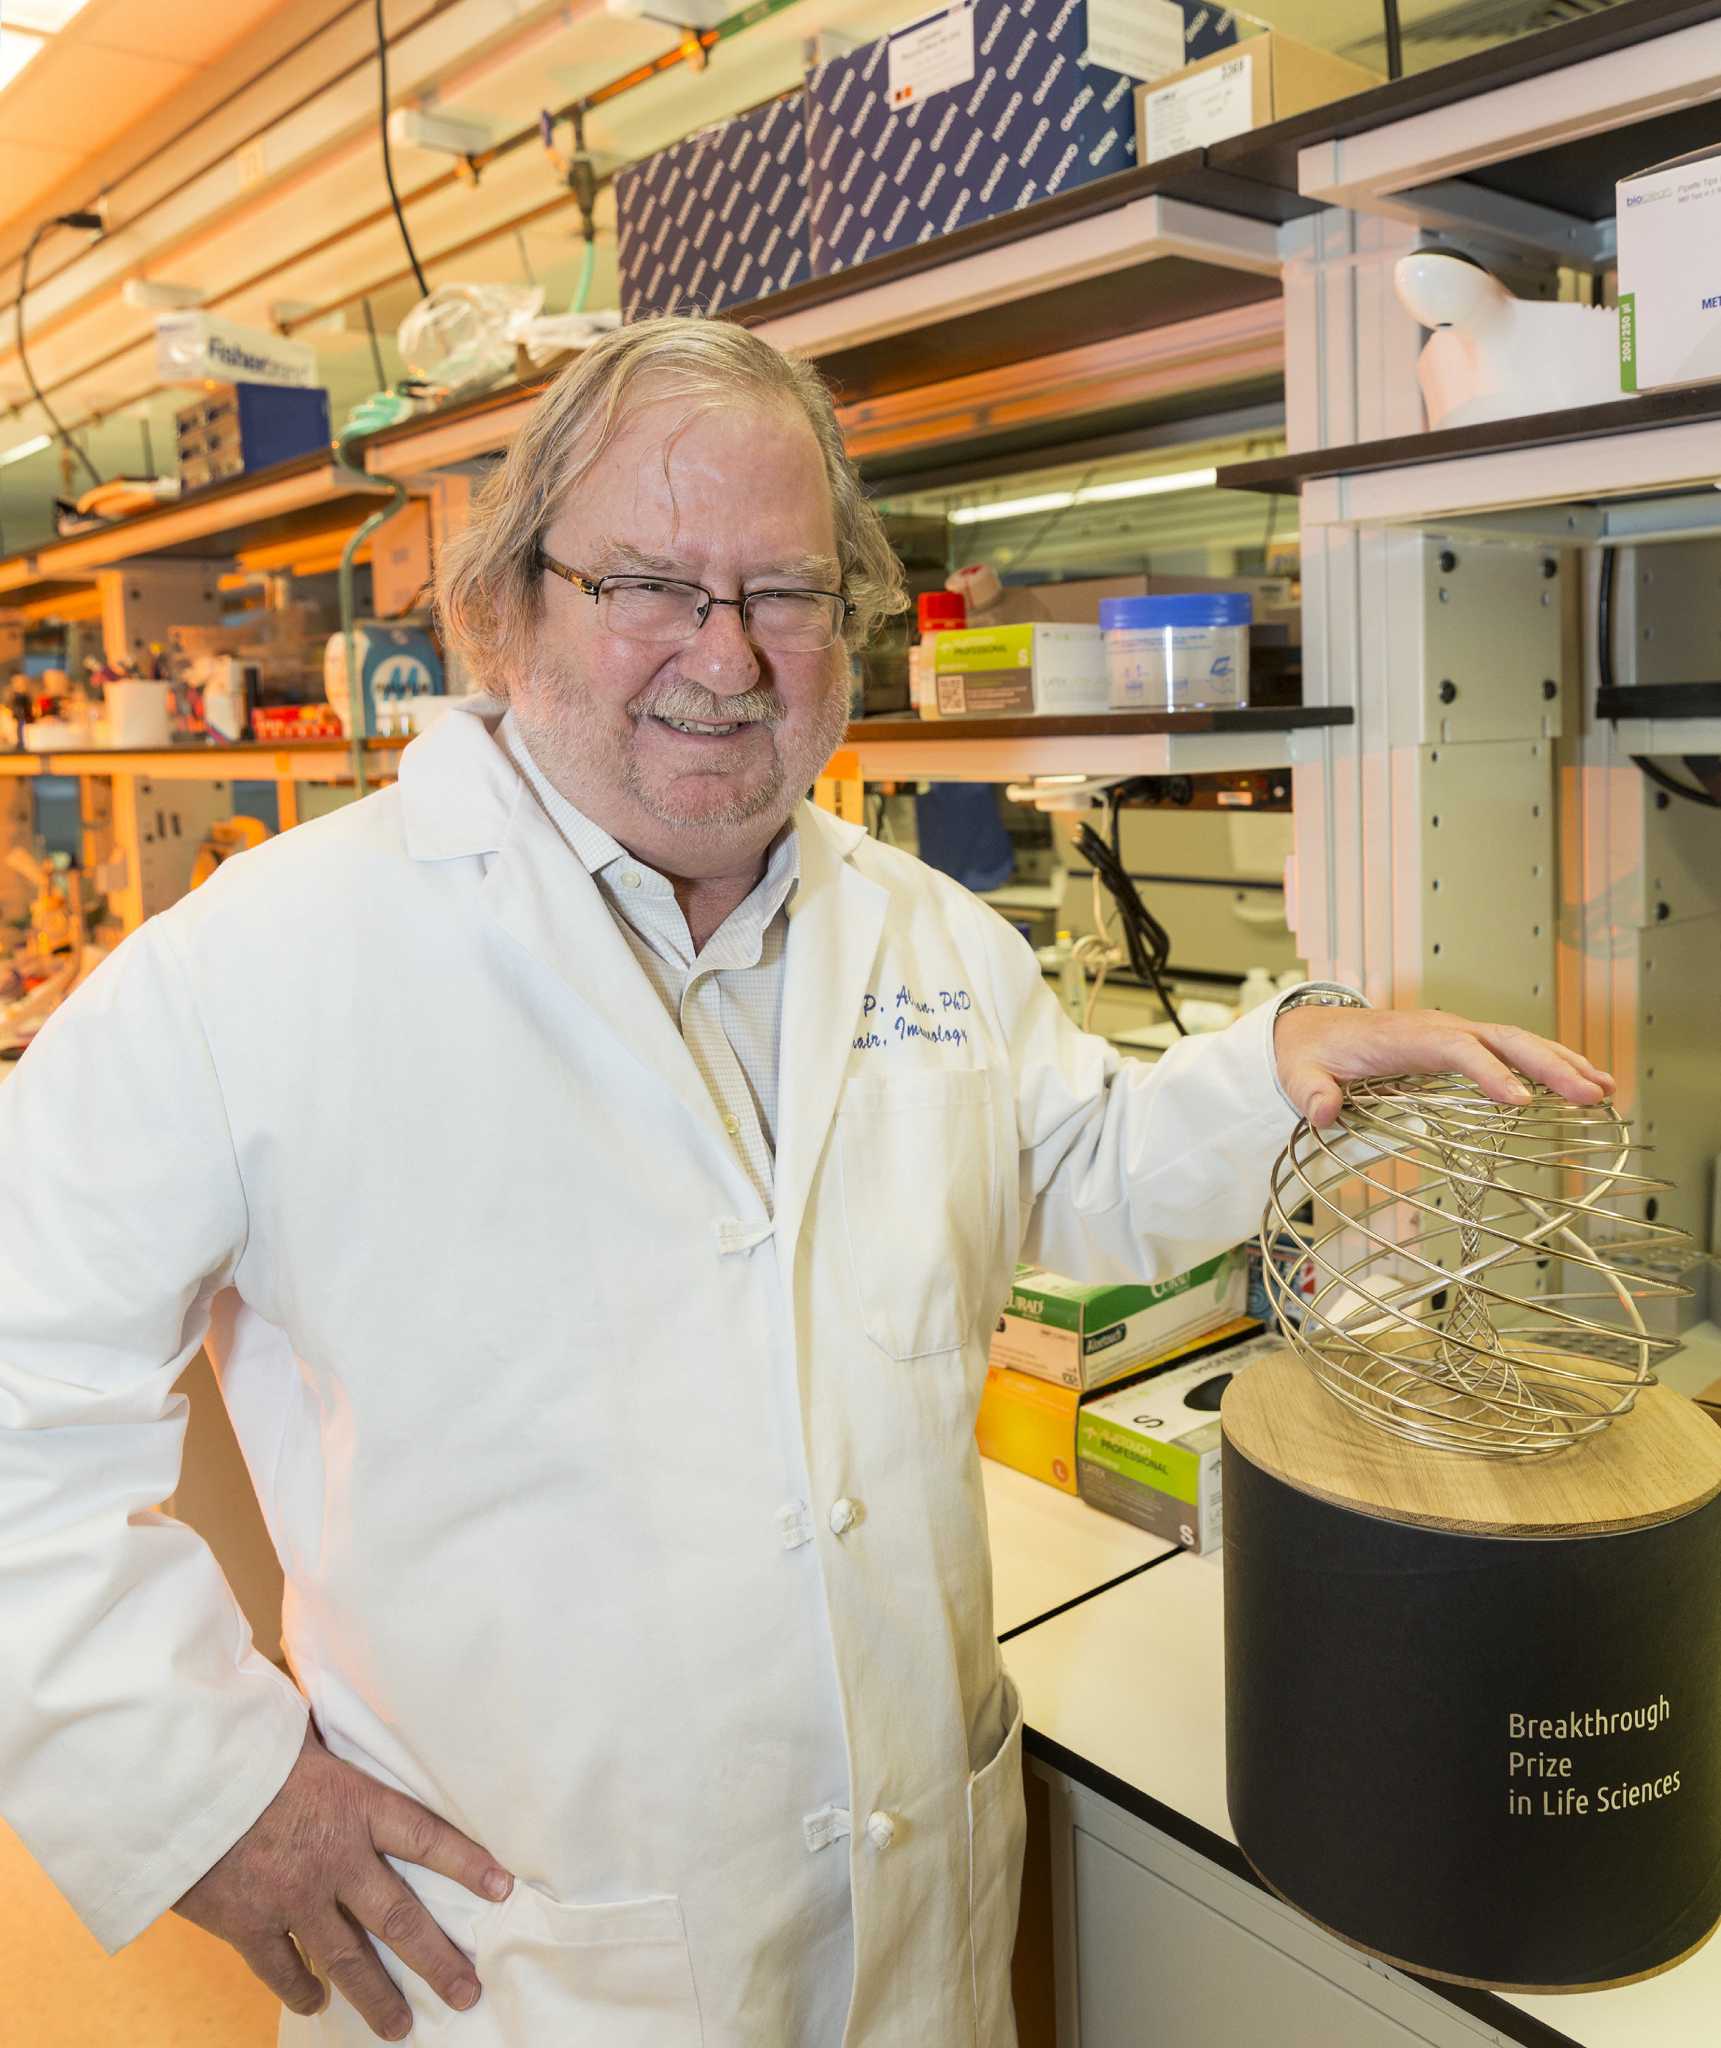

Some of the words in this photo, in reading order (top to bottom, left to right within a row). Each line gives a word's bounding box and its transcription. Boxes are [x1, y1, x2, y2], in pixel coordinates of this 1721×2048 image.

[939, 991, 971, 1012] PhD
[1101, 1438, 1169, 1476] PROFESSIONAL
[1179, 1524, 1195, 1546] S
[1509, 1694, 1670, 1739] Breakthrough
[1509, 1752, 1573, 1778] Prize
[1509, 1789, 1532, 1815] in
[1543, 1788, 1590, 1816] Life
[1597, 1770, 1682, 1813] Sciences
